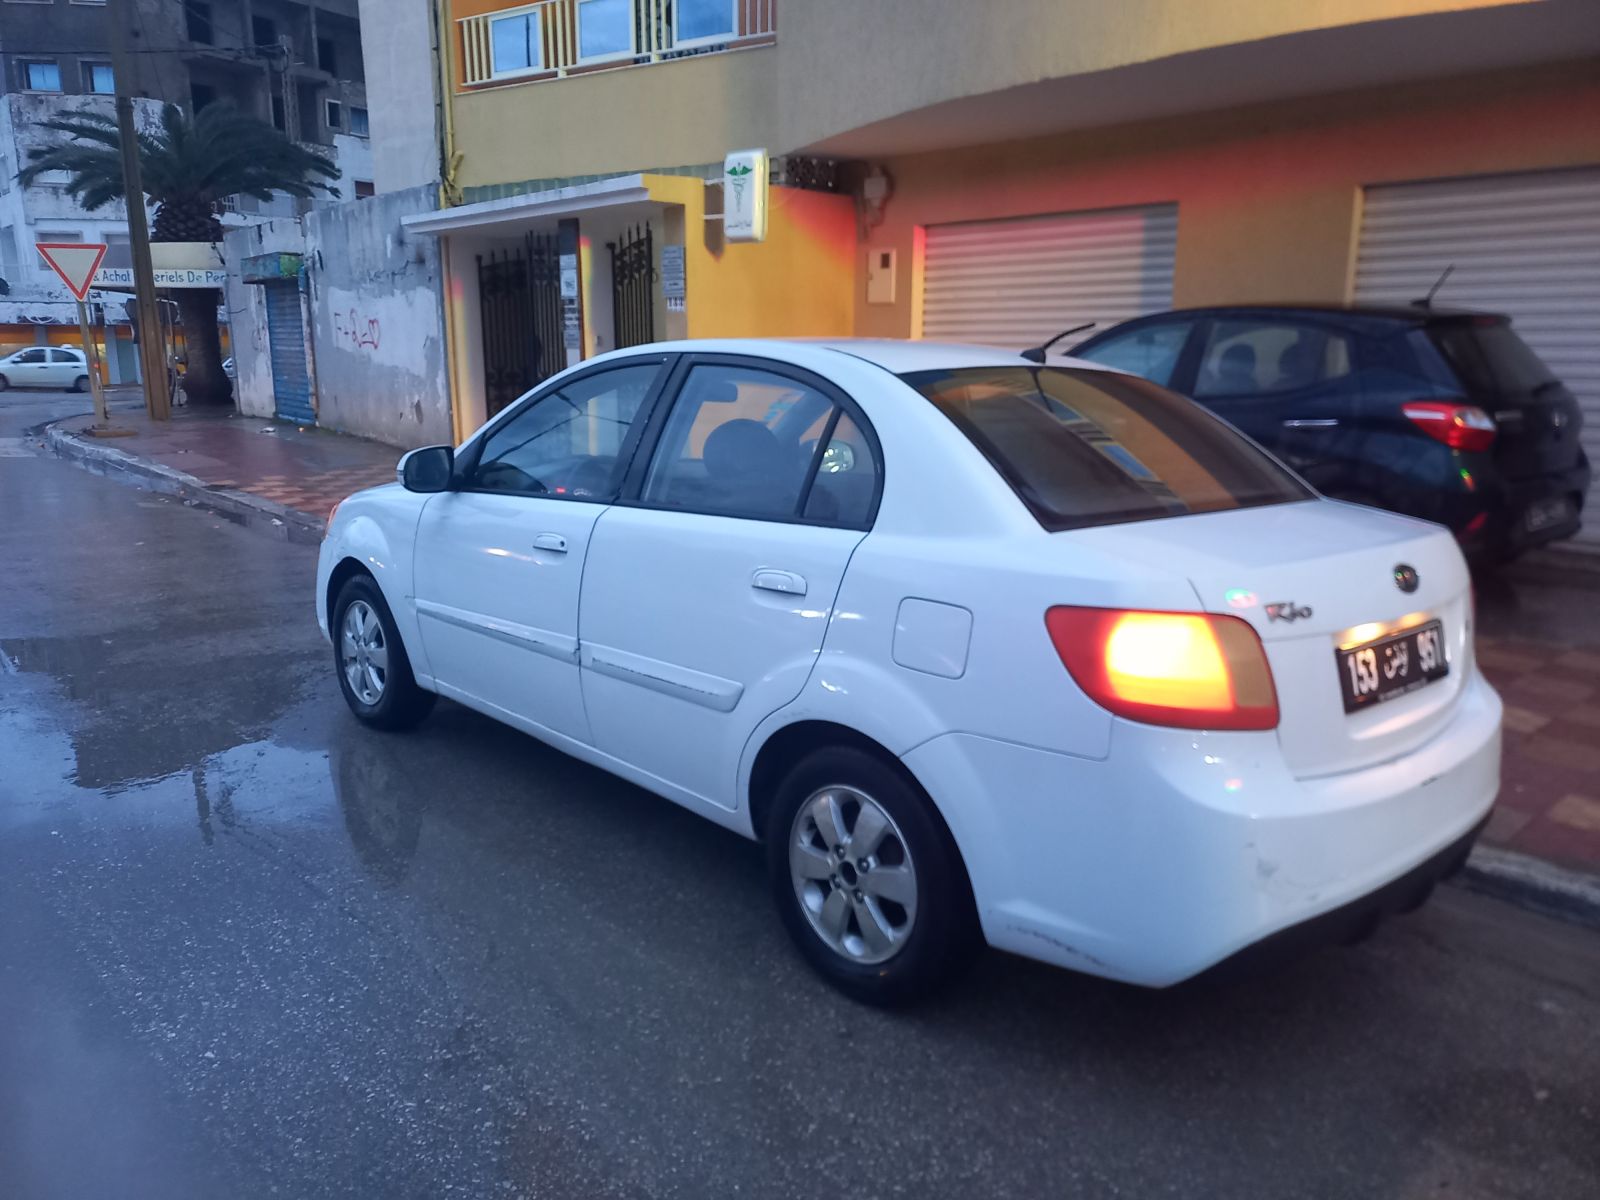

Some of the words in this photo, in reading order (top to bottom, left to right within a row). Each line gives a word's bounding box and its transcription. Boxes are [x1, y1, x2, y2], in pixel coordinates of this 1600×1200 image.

[154, 271, 185, 283] eriels
[1264, 601, 1313, 625] Rio
[1347, 647, 1379, 697] 153
